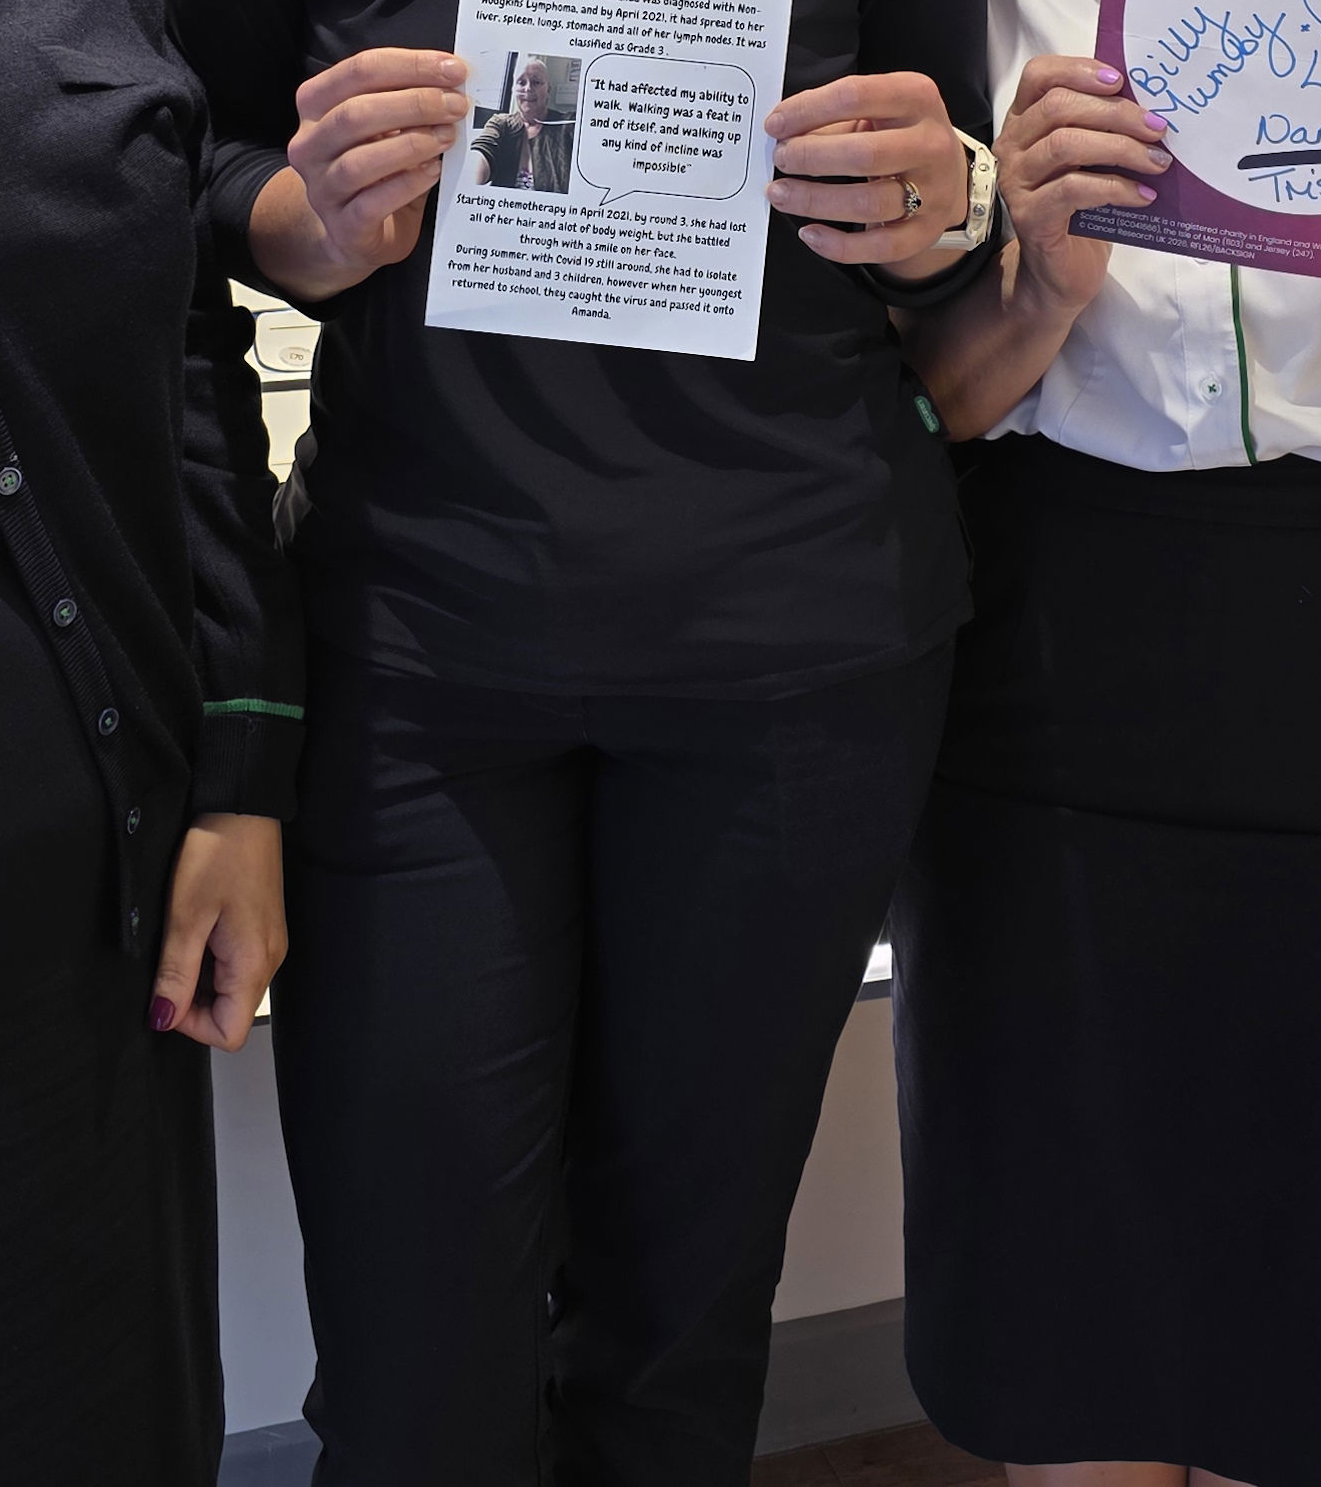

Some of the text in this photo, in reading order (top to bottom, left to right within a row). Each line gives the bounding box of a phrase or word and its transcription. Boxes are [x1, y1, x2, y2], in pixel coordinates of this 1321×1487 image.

[580, 4, 598, 14] and
[600, 5, 613, 19] by
[615, 7, 639, 21] April
[641, 10, 667, 23] 2021,
[669, 12, 677, 23] it
[679, 14, 697, 25] had
[699, 17, 732, 29] spread
[734, 20, 744, 30] to
[747, 20, 764, 31] her
[712, 1, 734, 12] with
[737, 3, 760, 14] Non-
[475, 10, 766, 48] liver, spleen, lungs, stomach and all of her lymph nodes. It was
[569, 37, 612, 49] classified
[614, 42, 624, 51] as
[626, 42, 655, 54] Grade
[1129, 6, 1244, 97] Billy
[590, 78, 748, 106] "It had affected my ability to
[593, 99, 741, 122] walk. Walking was a feat in
[589, 116, 741, 144] and of itself, and walking up
[601, 138, 722, 158] any kind of incline was
[632, 157, 691, 173] impossible"
